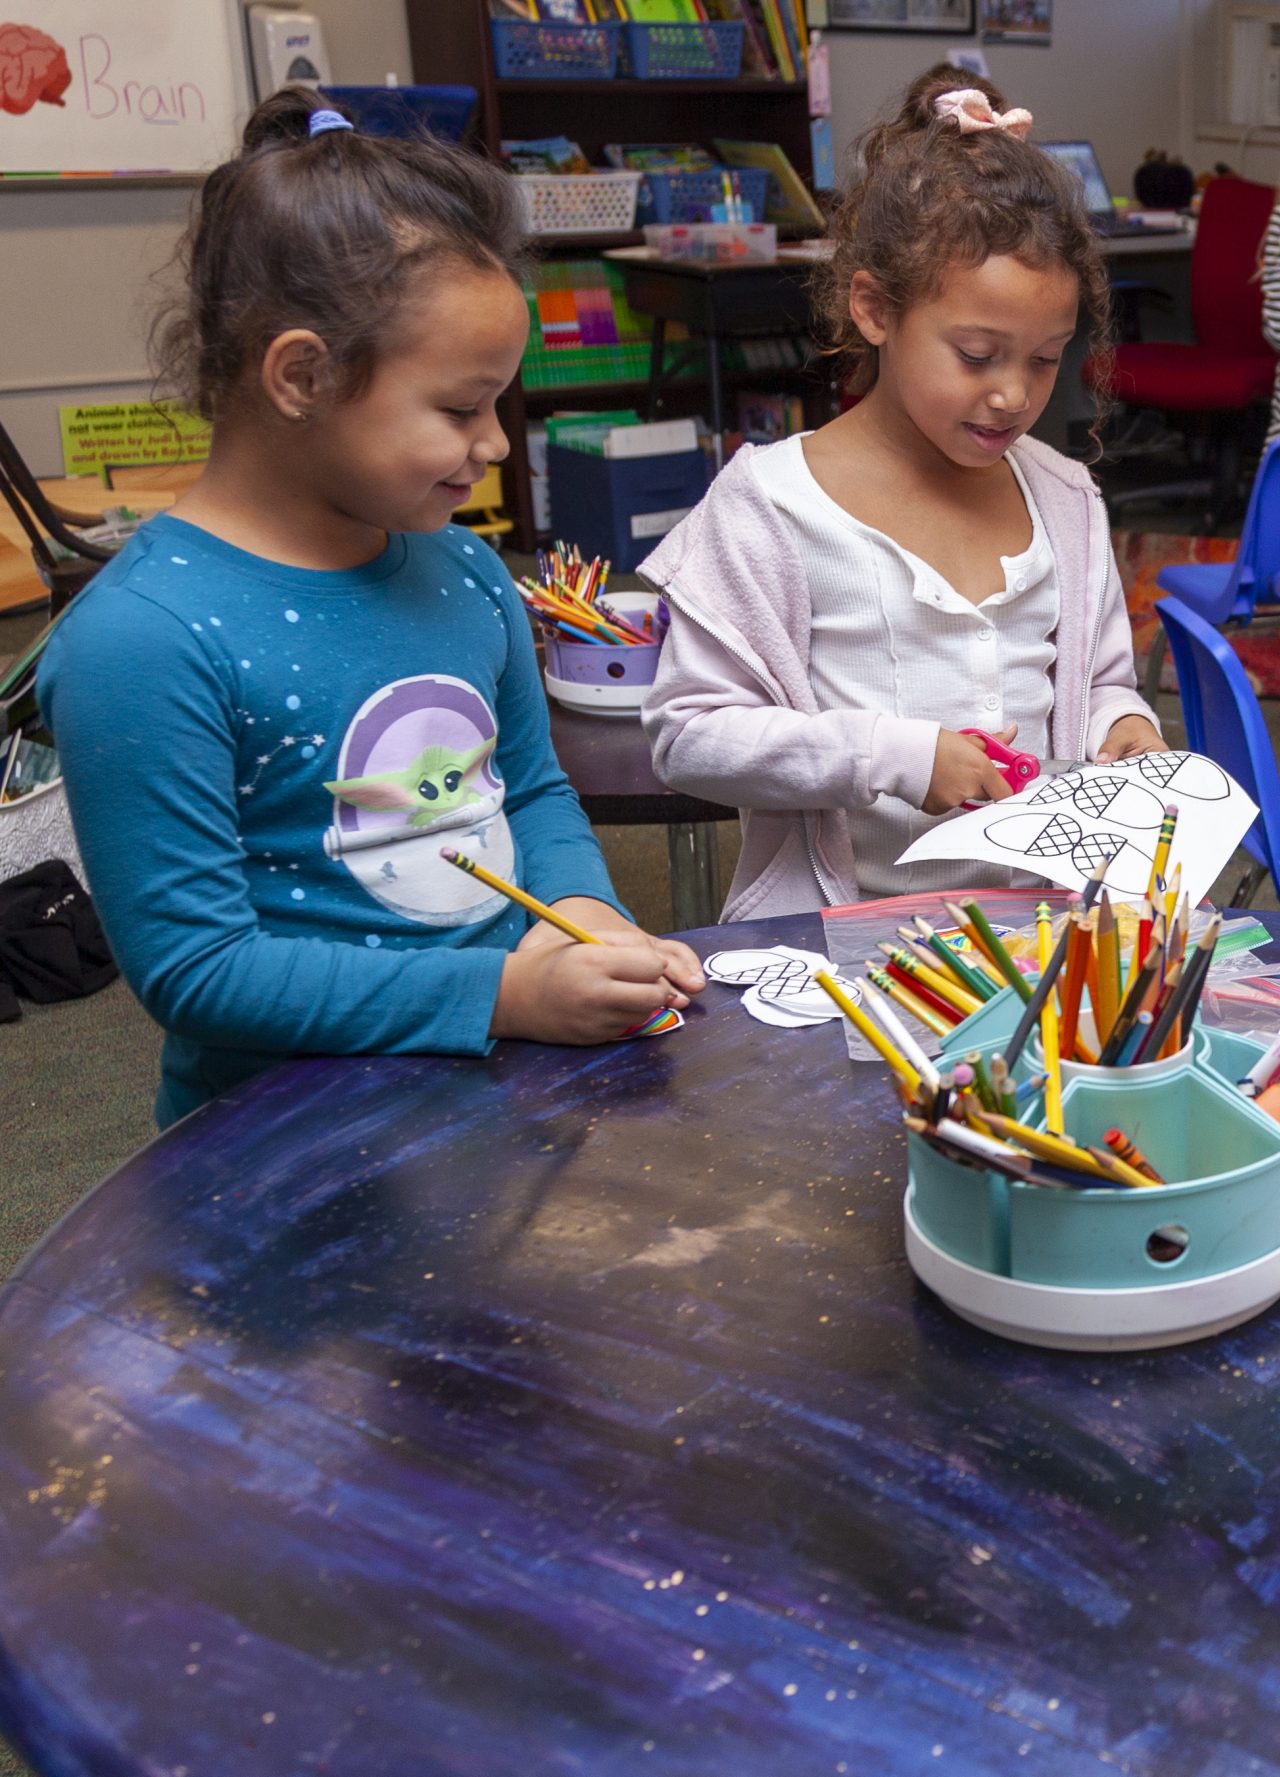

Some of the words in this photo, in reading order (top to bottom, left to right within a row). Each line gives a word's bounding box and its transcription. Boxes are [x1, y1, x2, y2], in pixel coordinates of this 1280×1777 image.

[79, 33, 206, 122] Brain
[75, 406, 126, 419] Animals
[69, 423, 89, 434] not
[93, 421, 123, 431] wear
[79, 438, 125, 449] Written
[128, 437, 143, 447] by
[72, 452, 96, 463] and
[100, 450, 140, 461] drawn
[143, 449, 157, 459] by
